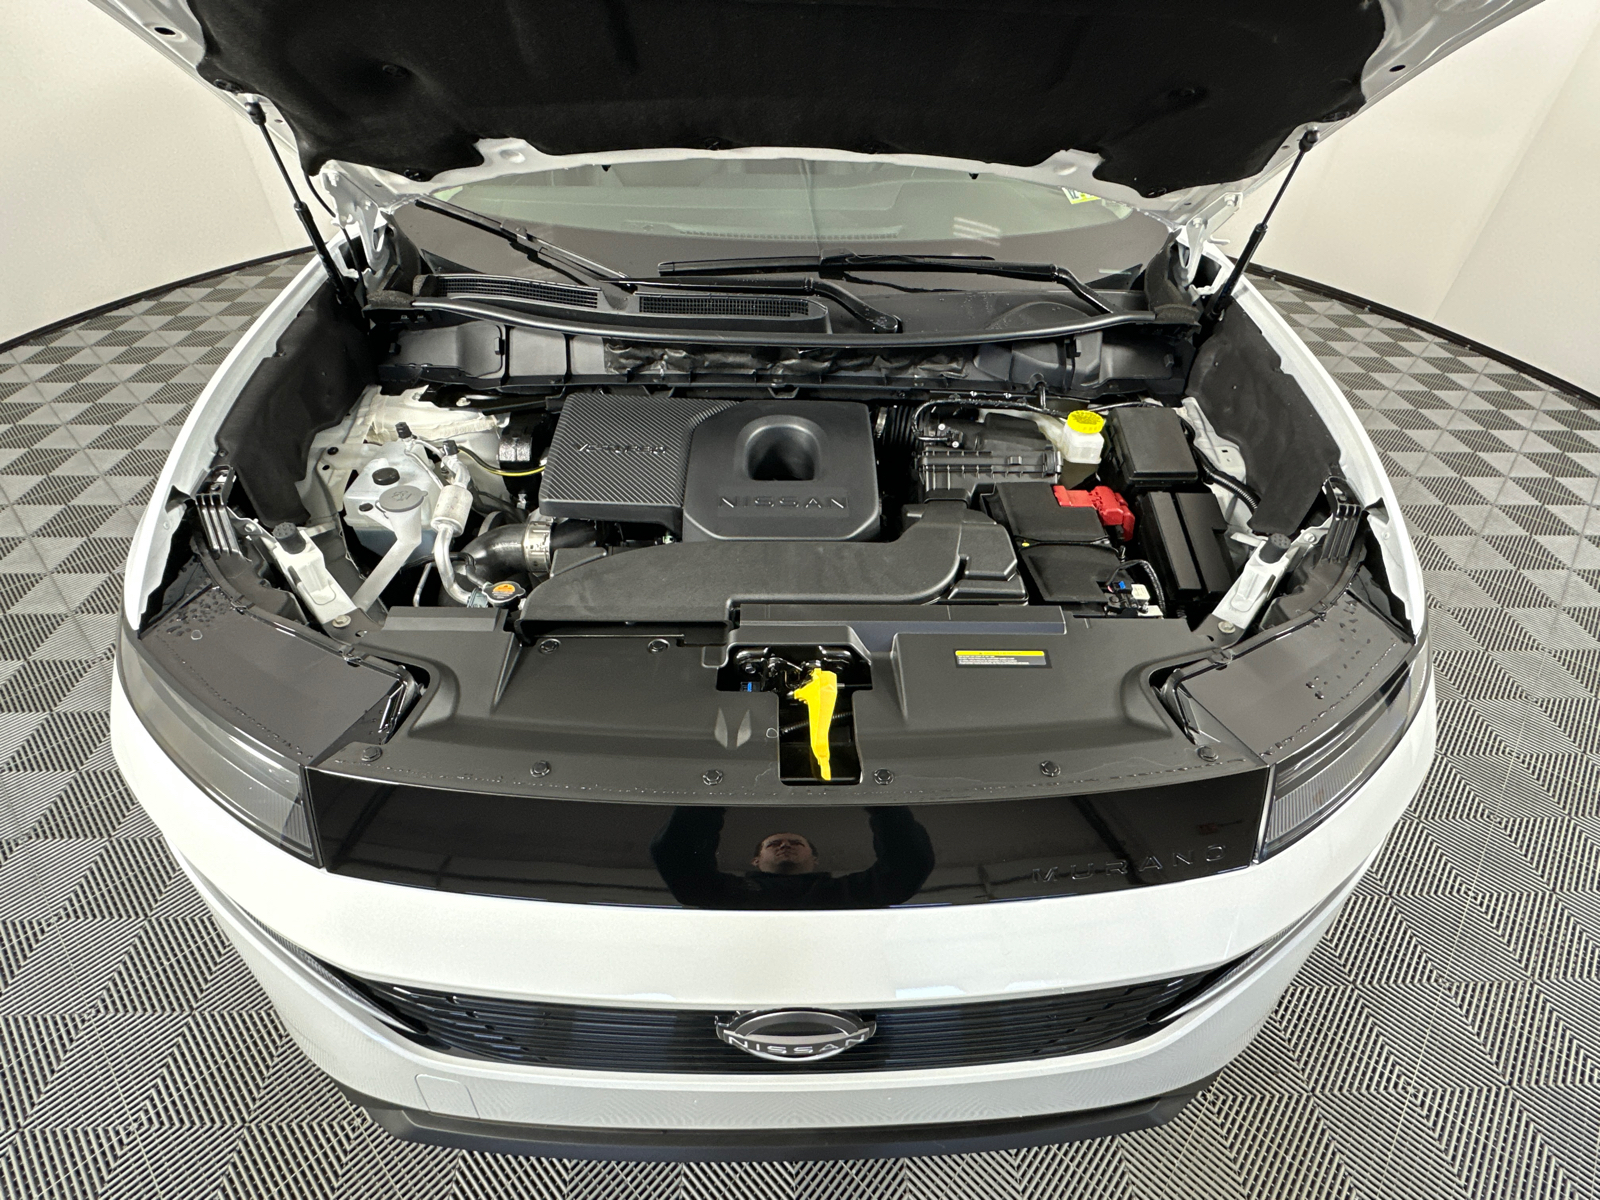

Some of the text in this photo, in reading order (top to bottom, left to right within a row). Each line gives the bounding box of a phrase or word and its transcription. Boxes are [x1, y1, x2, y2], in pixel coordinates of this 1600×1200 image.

[718, 497, 849, 509] NISSAN
[1032, 844, 1226, 883] MURANO
[728, 1034, 866, 1054] NISSAN
